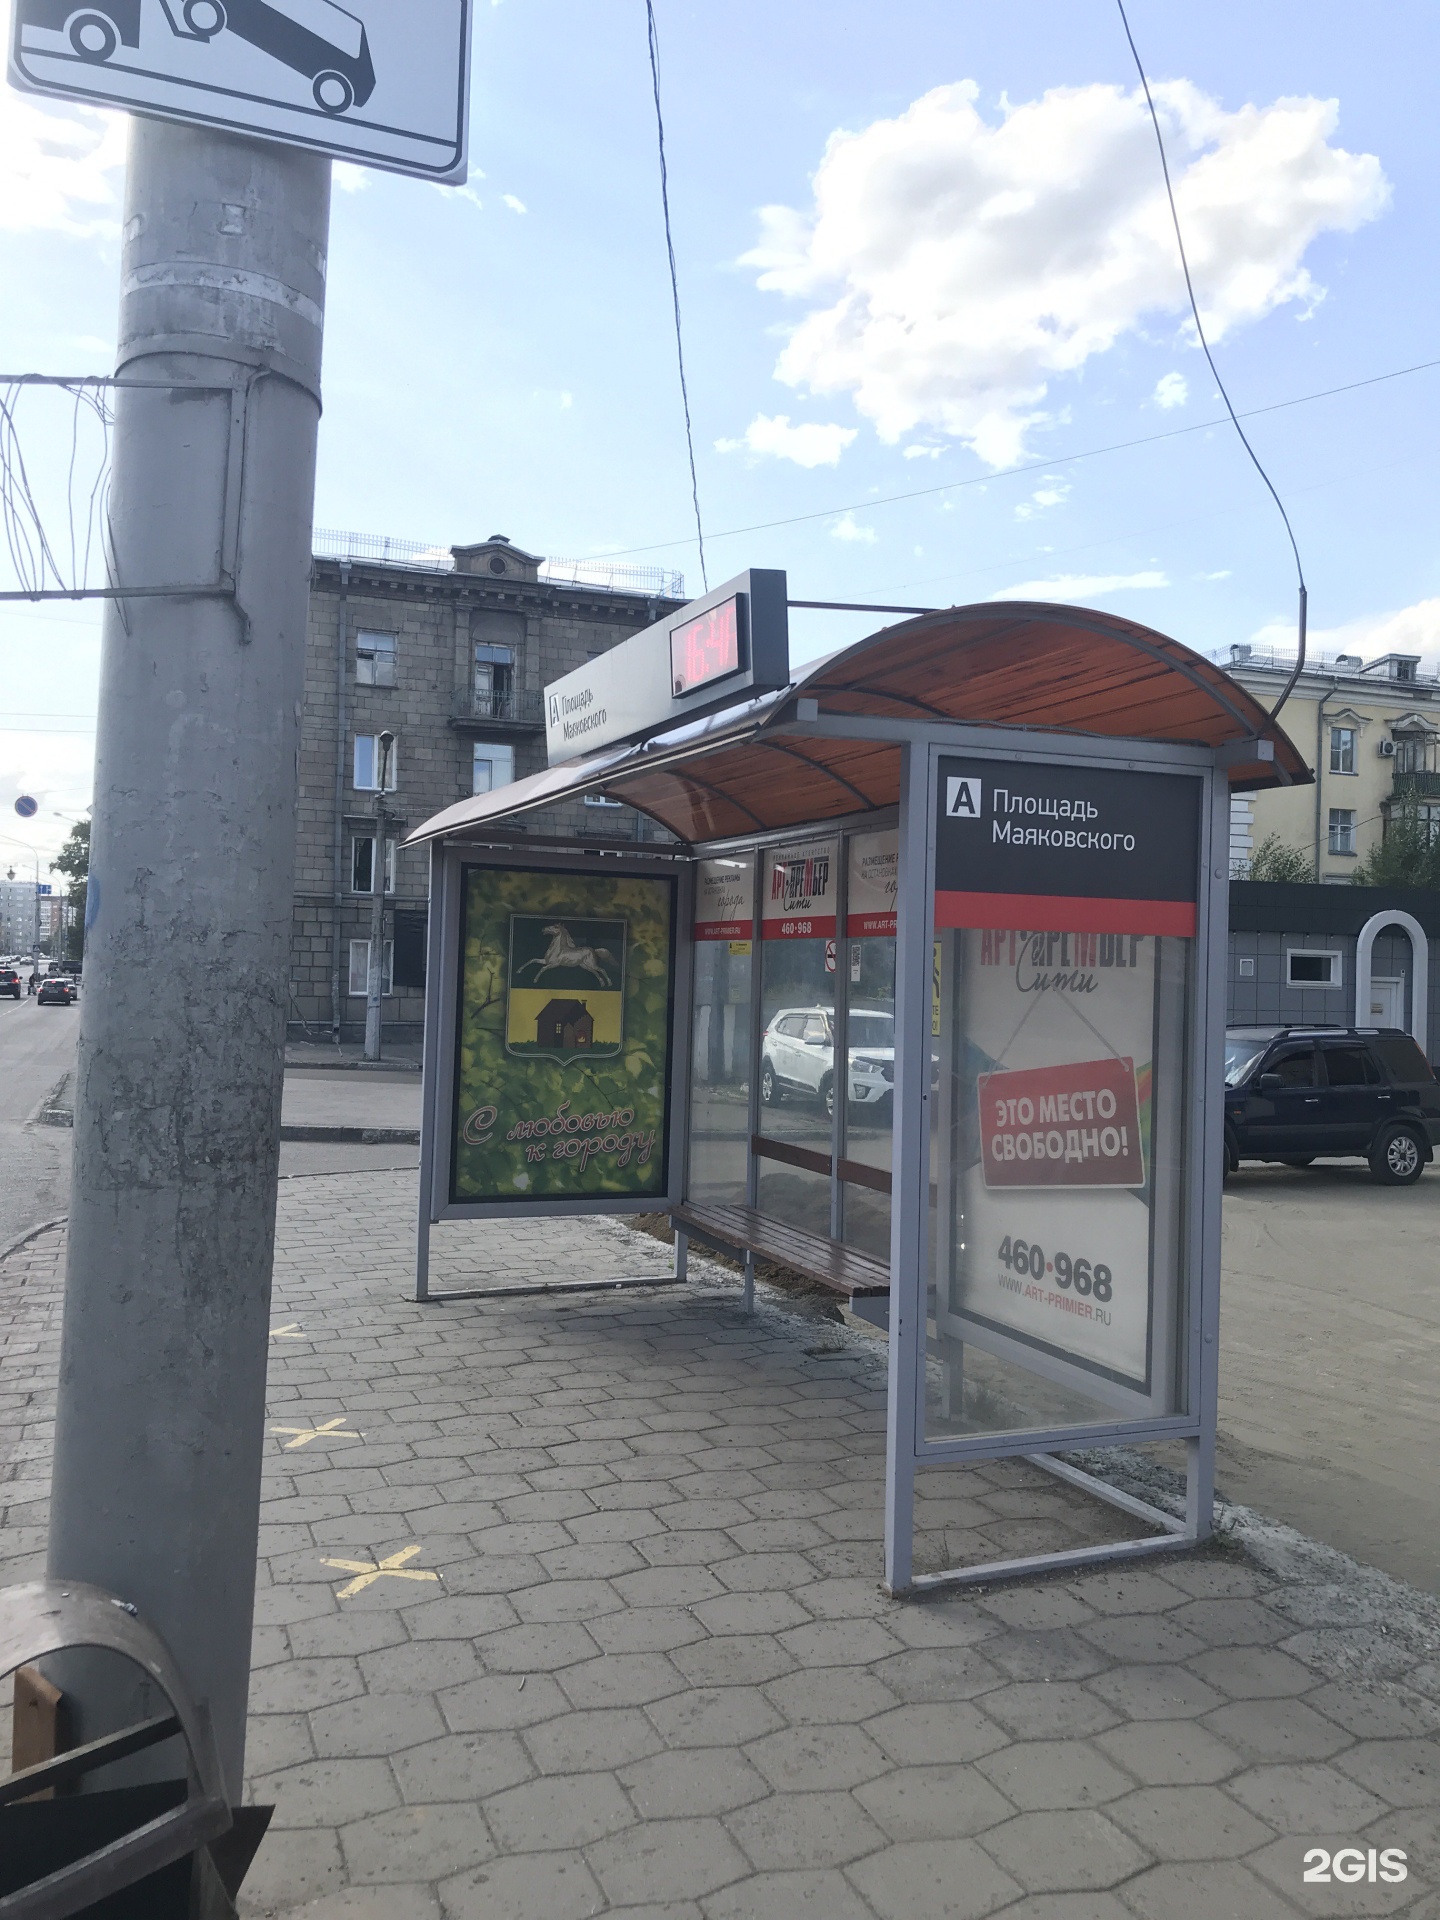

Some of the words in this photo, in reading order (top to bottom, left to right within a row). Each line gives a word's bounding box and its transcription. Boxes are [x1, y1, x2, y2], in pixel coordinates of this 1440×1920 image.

[562, 689, 593, 716] Площадь
[563, 708, 606, 741] Маяковского
[993, 788, 1098, 822] Площадь
[992, 820, 1136, 852] Маяковского
[463, 1104, 498, 1146] С
[506, 1099, 635, 1141] любовью
[995, 1096, 1035, 1128] ЭТО
[1039, 1088, 1117, 1124] МЕСТО
[525, 1141, 546, 1163] к
[552, 1128, 656, 1173] городу
[991, 1126, 1129, 1163] СВОБОДНО!
[997, 1273, 1112, 1327] WWW.ART-PRIMIER.RU
